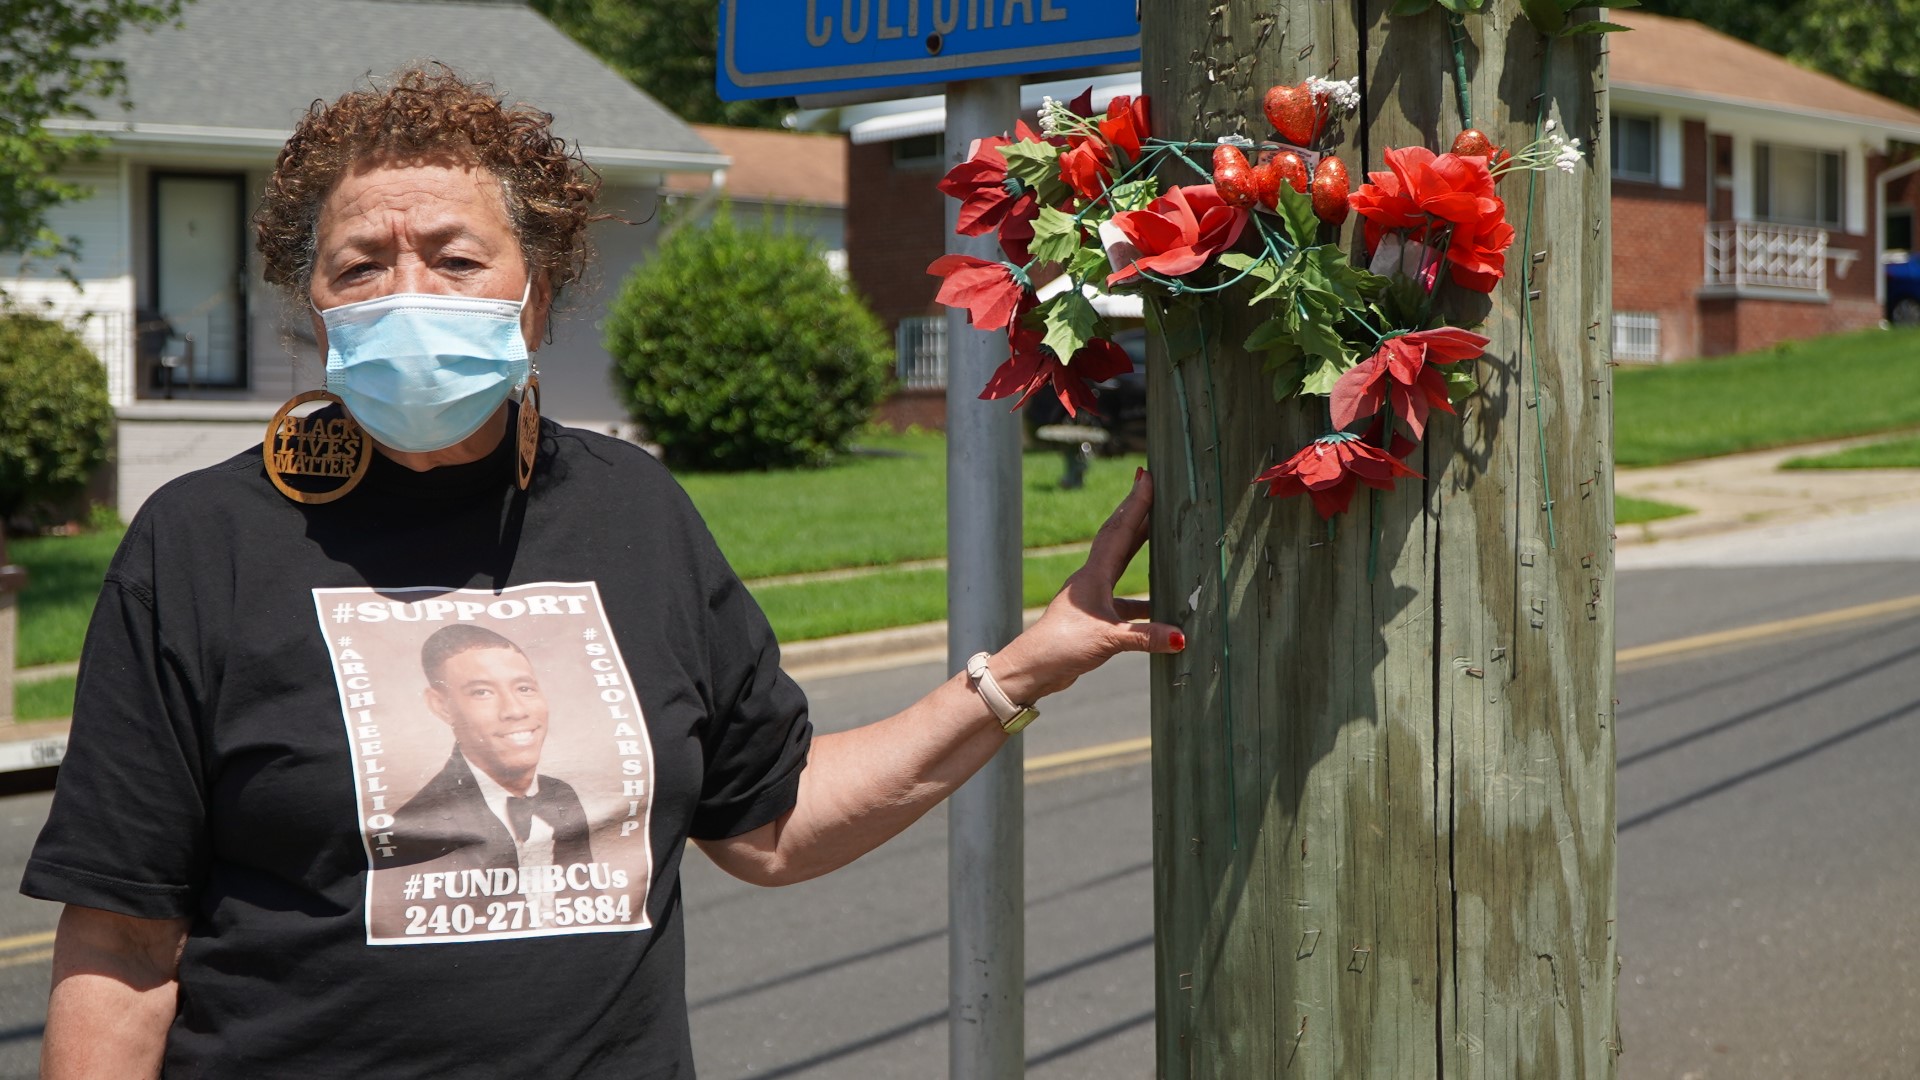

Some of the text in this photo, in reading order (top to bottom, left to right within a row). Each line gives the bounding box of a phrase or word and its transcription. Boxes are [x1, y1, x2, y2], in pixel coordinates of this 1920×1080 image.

[805, 0, 1067, 47] CULU
[279, 416, 360, 440] BLACK
[277, 435, 360, 459] LIVES
[274, 453, 356, 478] MATTER
[332, 595, 587, 623] #SUPPORT
[582, 628, 645, 837] #SCHOLARSHIP
[405, 894, 631, 935] 240-271-5884
